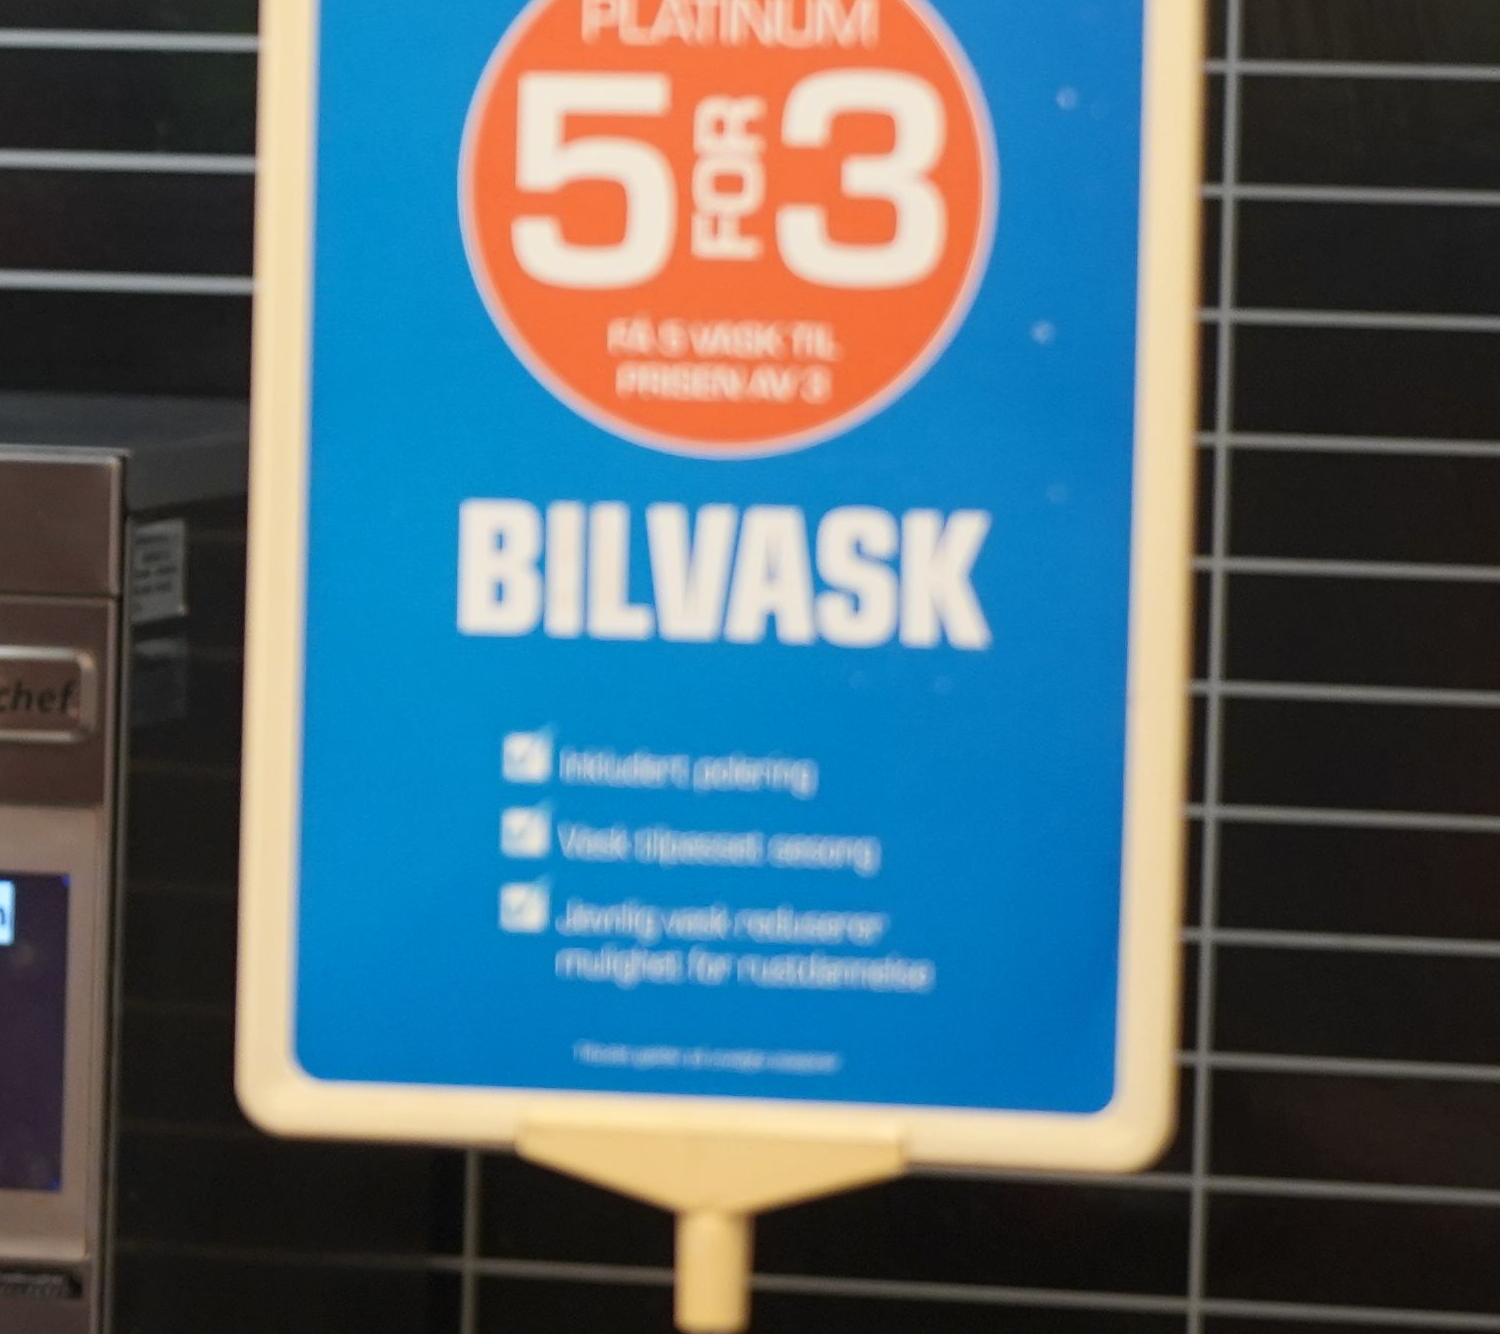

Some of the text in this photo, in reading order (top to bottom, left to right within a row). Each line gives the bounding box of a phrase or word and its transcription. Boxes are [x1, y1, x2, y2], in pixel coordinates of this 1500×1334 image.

[509, 68, 947, 289] 5 FOR 3
[691, 319, 783, 360] VASK
[458, 499, 992, 650] BILVASK
